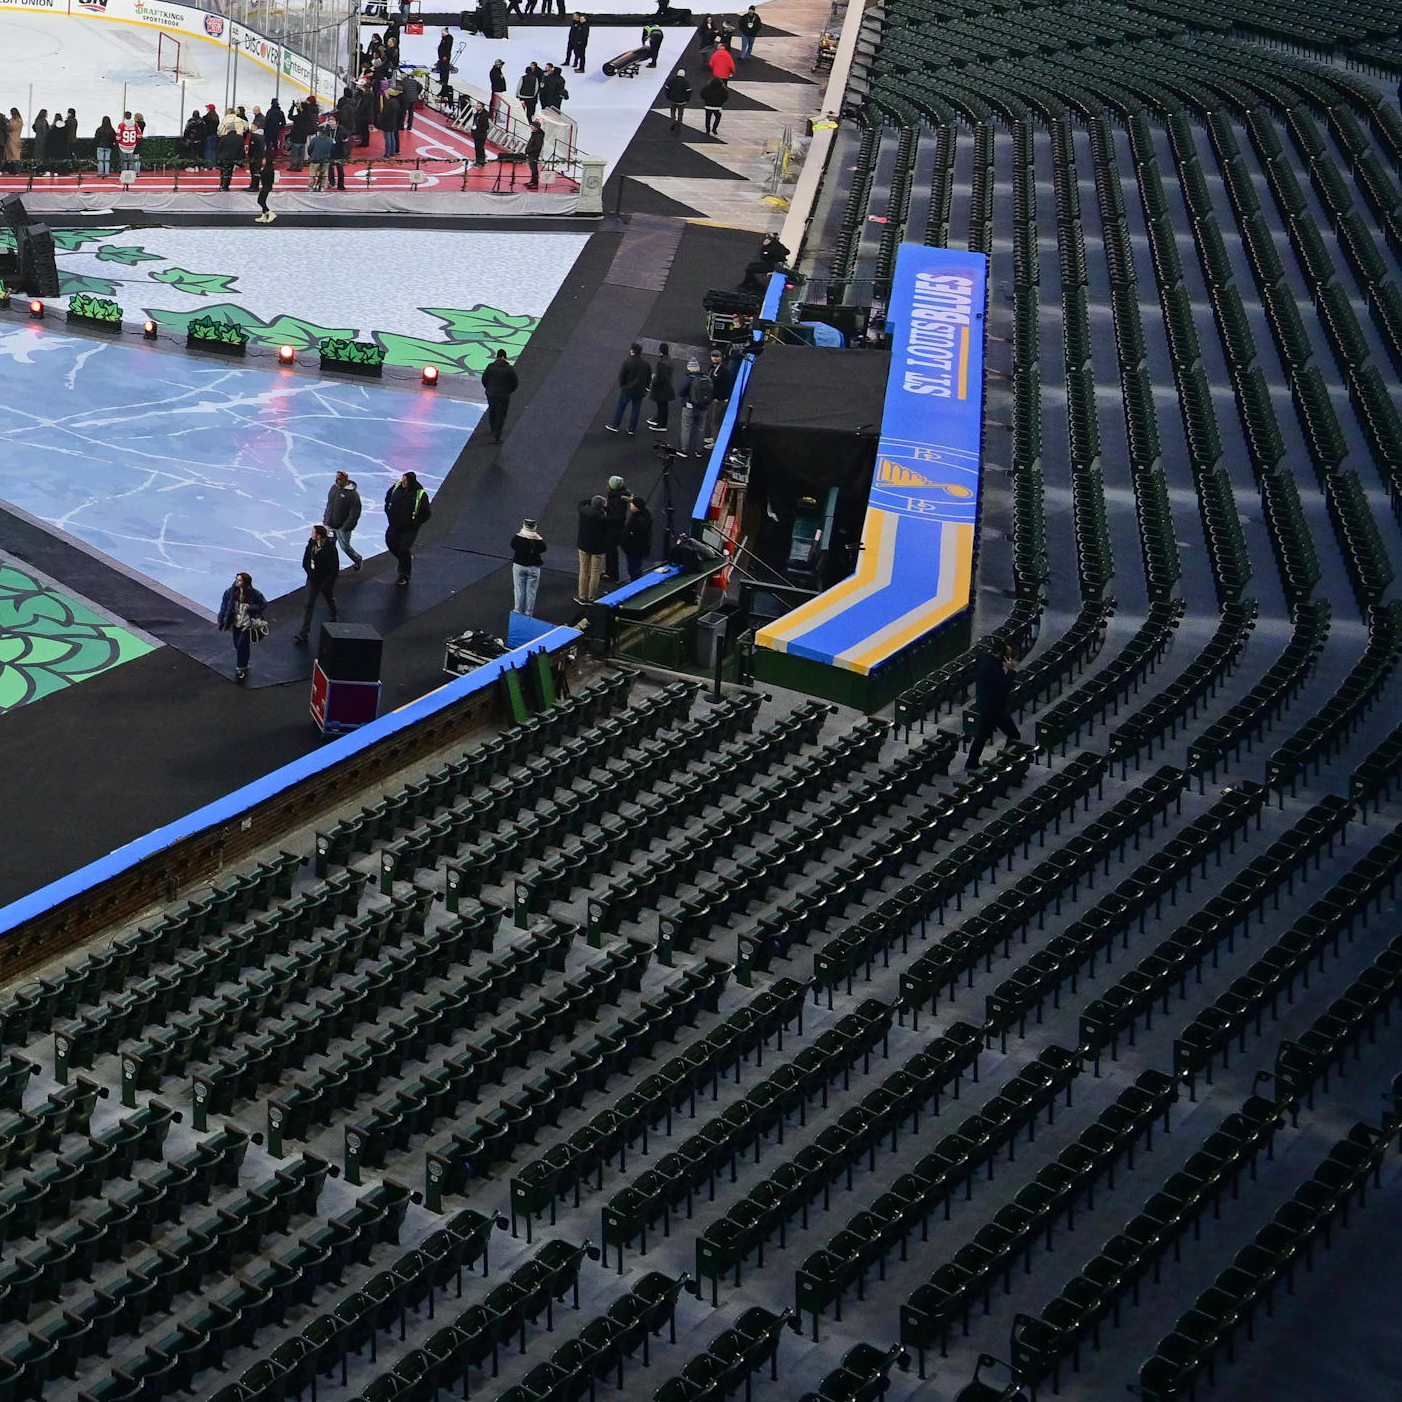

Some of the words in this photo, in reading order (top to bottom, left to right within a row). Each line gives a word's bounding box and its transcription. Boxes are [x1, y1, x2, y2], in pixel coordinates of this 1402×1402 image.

[142, 15, 180, 27] SPORTSBOOK
[245, 33, 281, 69] DISCOVER
[122, 130, 137, 143] 98
[911, 272, 973, 325] BLUES
[906, 319, 956, 371] LOUIS
